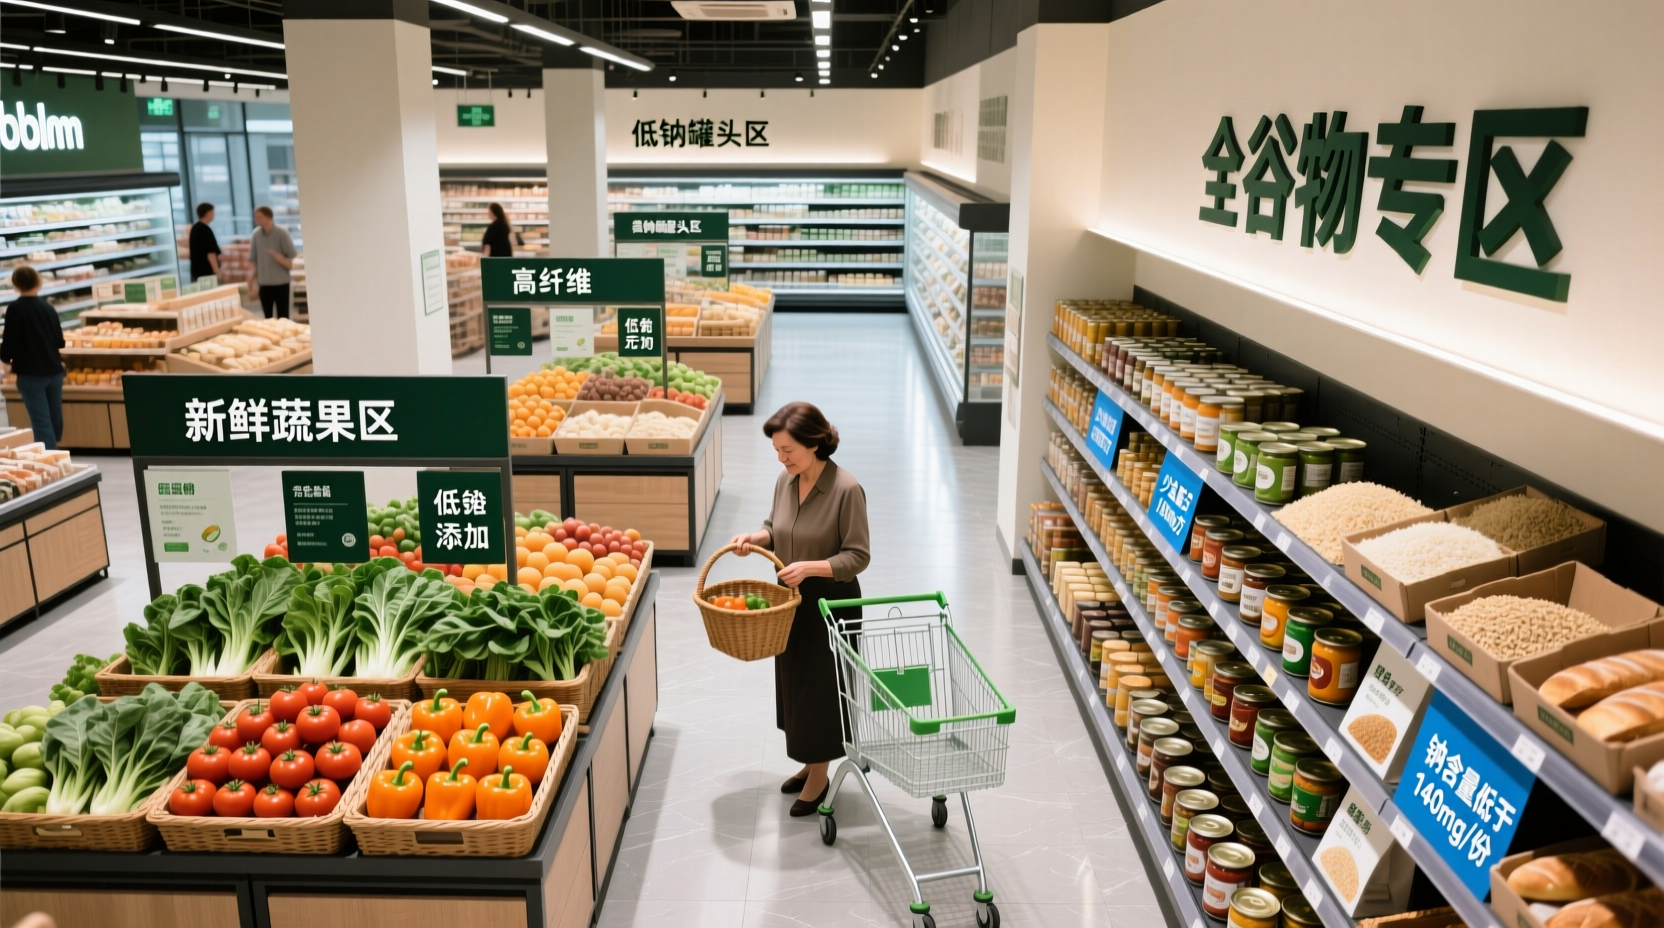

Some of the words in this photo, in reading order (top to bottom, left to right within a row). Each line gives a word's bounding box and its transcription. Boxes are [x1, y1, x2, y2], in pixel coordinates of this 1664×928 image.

[631, 118, 770, 148] 低钠罐头区
[1198, 104, 1590, 303] 全谷物专区
[511, 267, 592, 295] 高纤维
[185, 397, 399, 443] 新鲜蔬果区
[435, 522, 489, 551] 添加
[1424, 733, 1517, 832] 钠含量低于
[1413, 772, 1492, 868] 140mg/份
